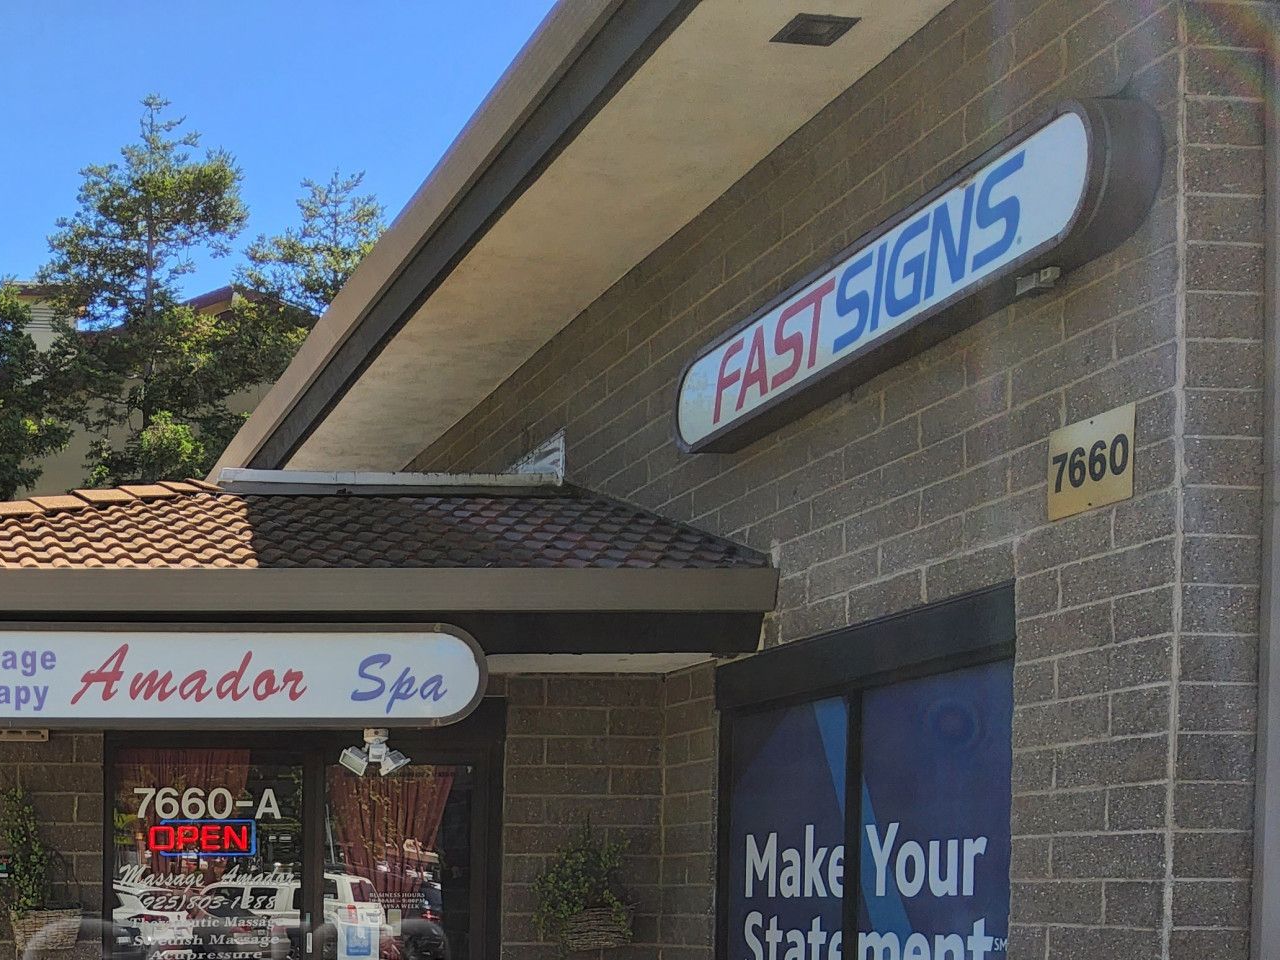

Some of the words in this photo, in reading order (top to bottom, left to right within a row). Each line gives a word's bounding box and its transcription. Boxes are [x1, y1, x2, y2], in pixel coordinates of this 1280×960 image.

[713, 150, 1026, 425] FASTSIGNS
[1052, 432, 1129, 494] 7660
[70, 643, 307, 705] Amador
[351, 653, 448, 714] Spa
[133, 787, 282, 820] 7660-A
[149, 825, 248, 851] OPEN
[743, 824, 845, 899] Make
[865, 821, 988, 898] Your
[119, 863, 206, 888] Massage
[221, 863, 295, 884] Amador
[209, 934, 280, 947] Massage
